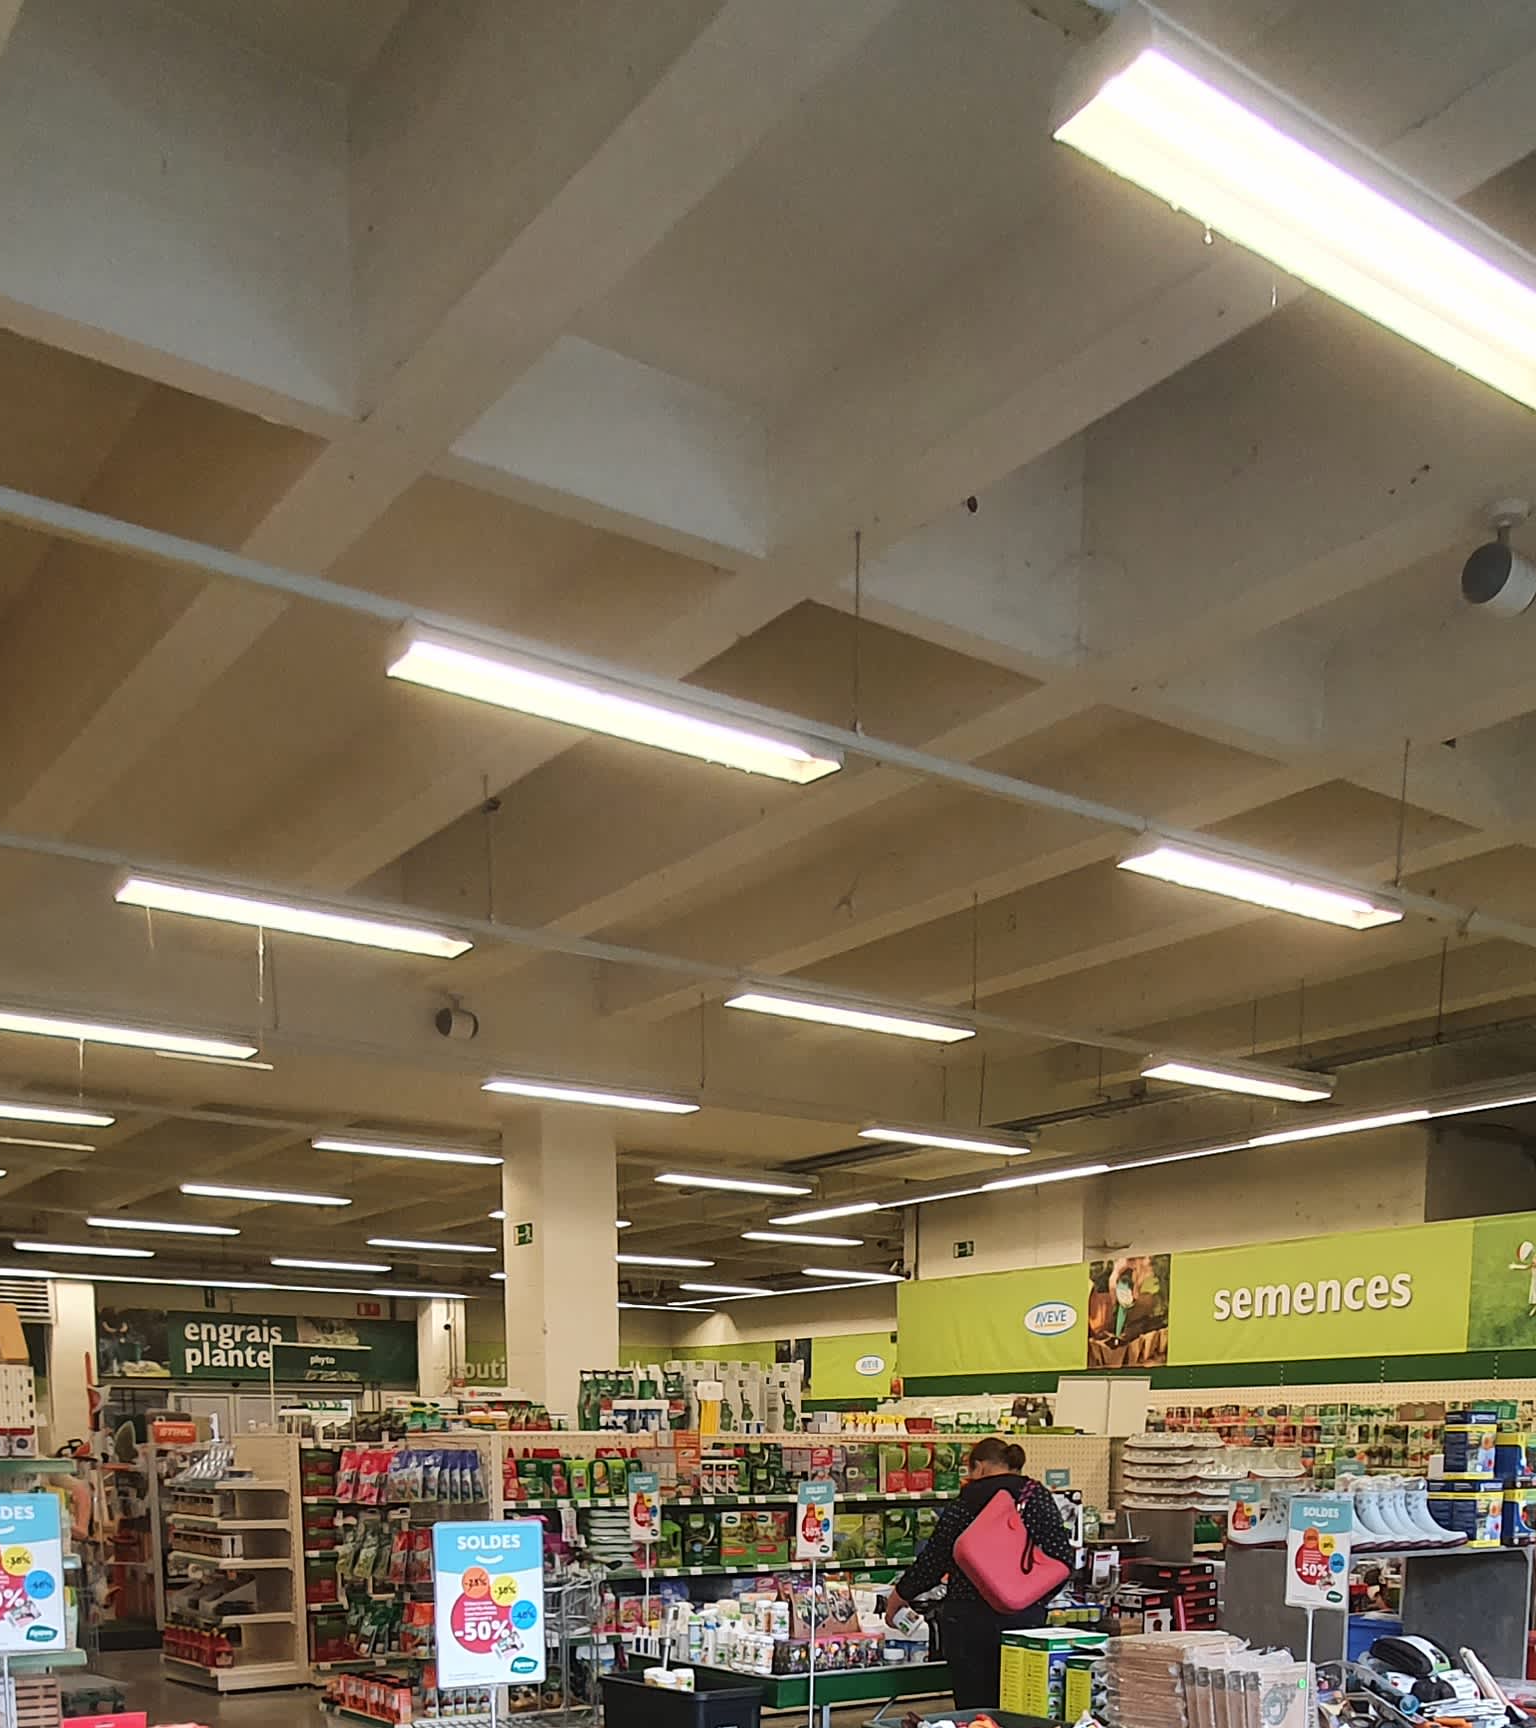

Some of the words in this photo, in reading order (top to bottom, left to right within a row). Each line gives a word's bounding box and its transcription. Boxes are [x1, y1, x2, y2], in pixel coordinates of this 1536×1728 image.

[1213, 1272, 1413, 1321] semences
[1034, 1309, 1068, 1324] AVEVE
[184, 1319, 282, 1349] engrais
[309, 1355, 337, 1366] phyto
[1303, 1506, 1340, 1519] SOLDES
[457, 1535, 521, 1550] SOLDES
[1296, 1563, 1329, 1577] -50%
[454, 1619, 510, 1642] -50%
